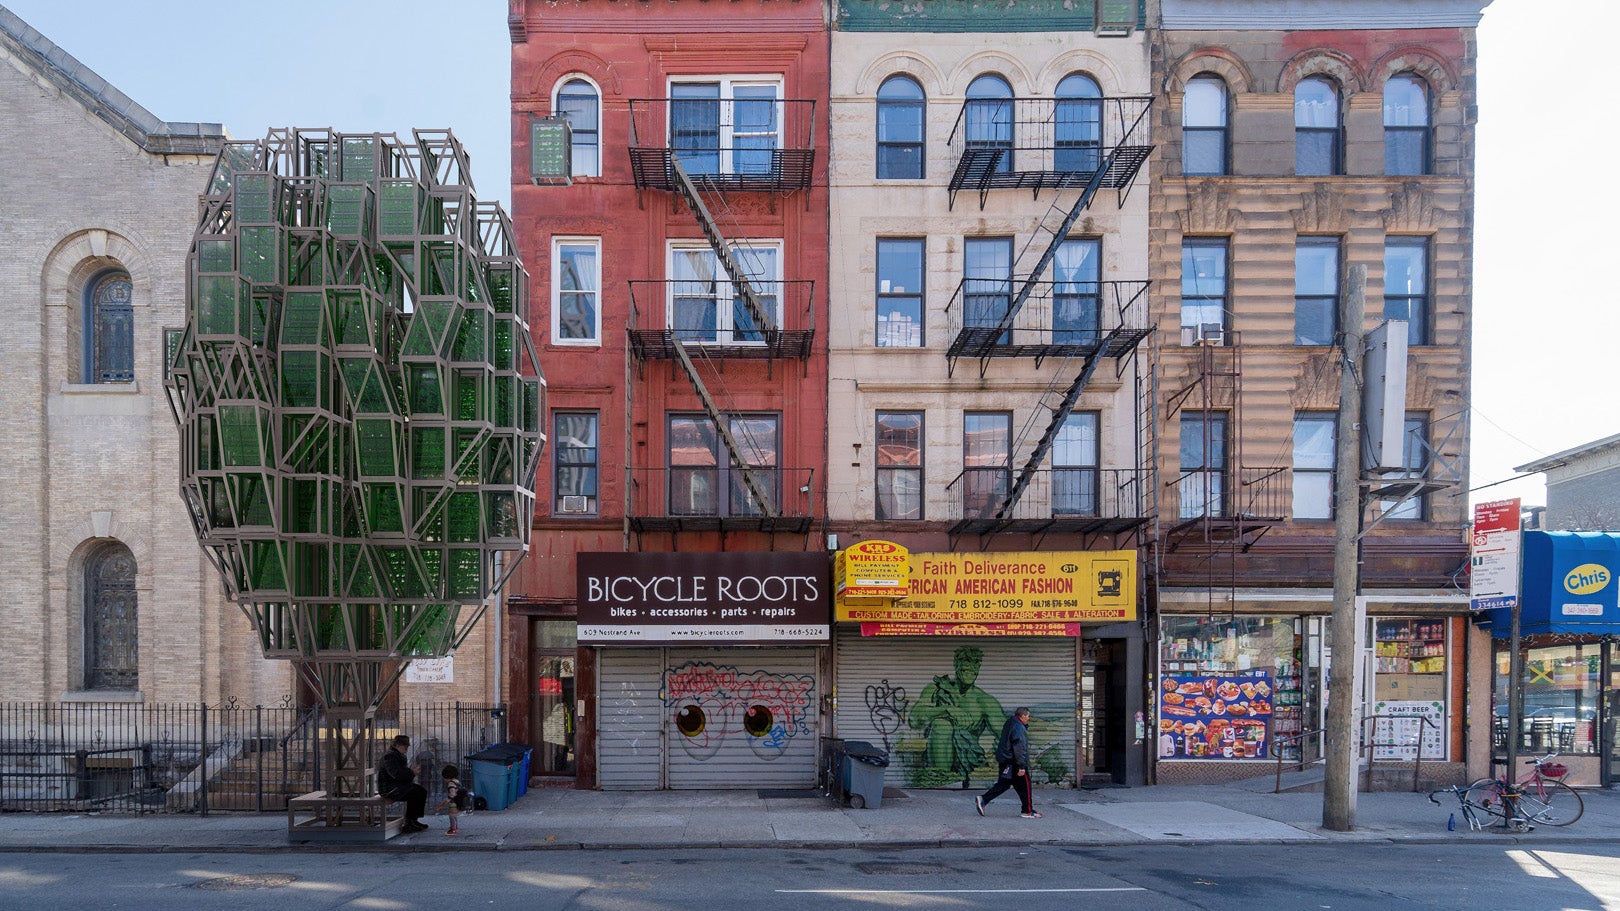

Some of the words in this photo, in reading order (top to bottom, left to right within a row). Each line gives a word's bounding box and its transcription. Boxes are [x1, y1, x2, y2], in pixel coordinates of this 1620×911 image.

[1486, 500, 1514, 509] STANDING
[923, 561, 957, 575] Faith
[964, 560, 1046, 575] Deliverance
[1567, 570, 1607, 590] Chris
[588, 576, 707, 602] BICYCLE
[718, 576, 819, 602] ROOTS
[955, 579, 1016, 595] AMERICAN
[1022, 577, 1073, 594] FASHION
[949, 599, 968, 609] 718
[973, 599, 1024, 609] 812-1099
[610, 606, 637, 616] bikes
[650, 607, 708, 616] accessories
[721, 606, 748, 618] parts
[760, 607, 796, 618] repairs
[891, 611, 912, 619] MADE
[917, 612, 955, 620] TAILORING
[958, 612, 1007, 620] EMBROIDERY
[1041, 611, 1061, 619] SALE
[1073, 610, 1119, 618] ALTERATION
[774, 628, 823, 636] 718-668-5224
[1255, 670, 1266, 678] EBT
